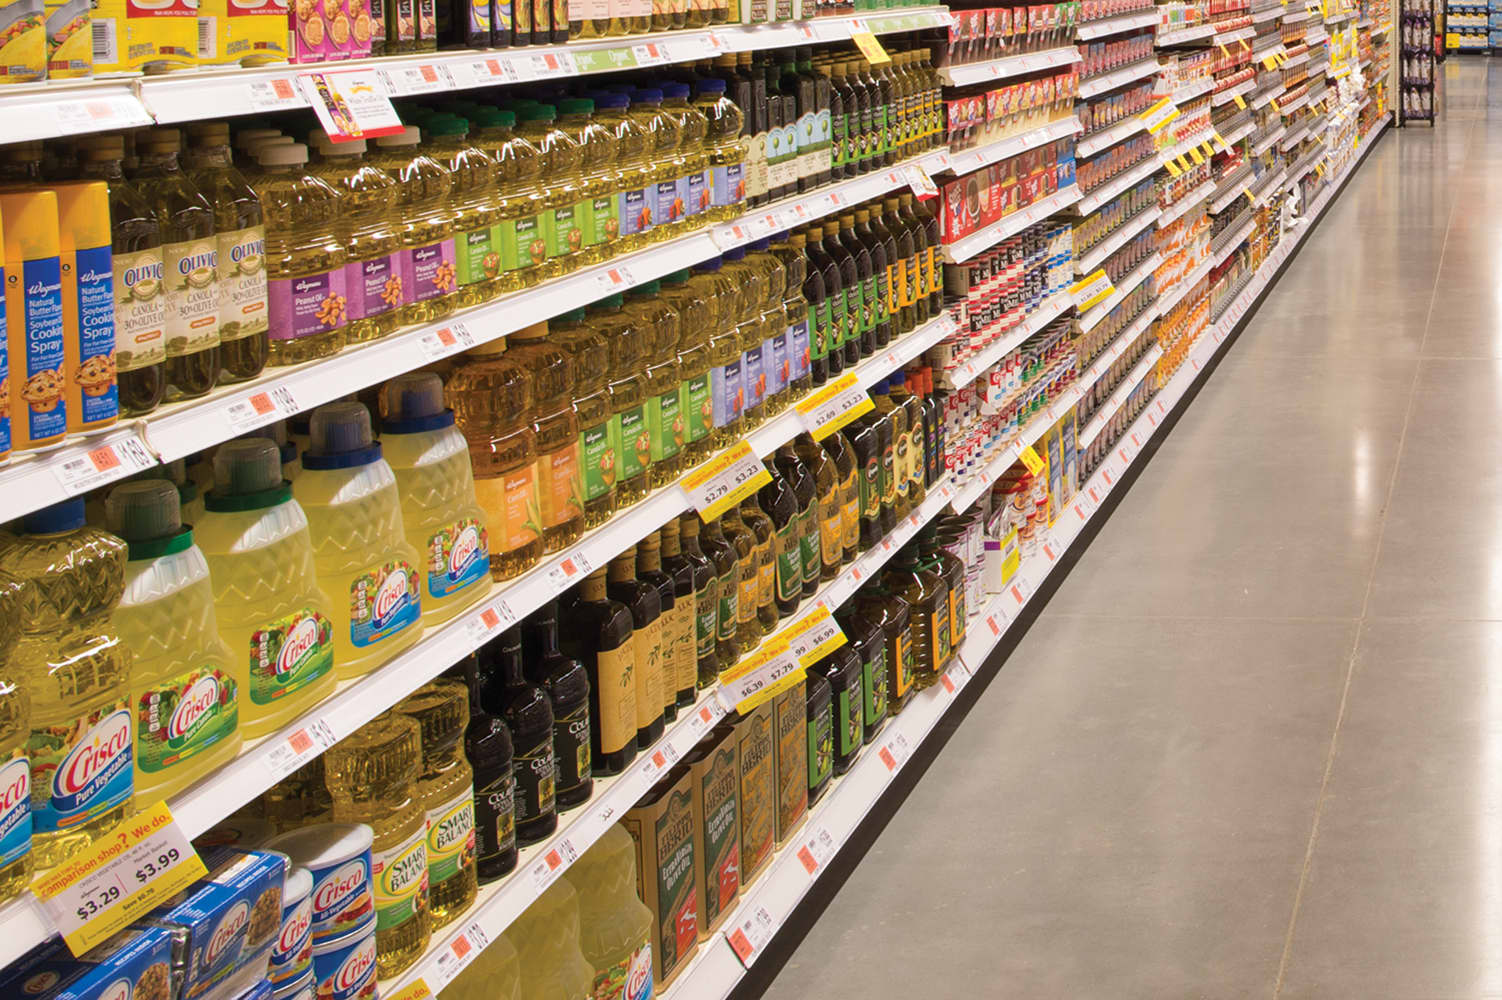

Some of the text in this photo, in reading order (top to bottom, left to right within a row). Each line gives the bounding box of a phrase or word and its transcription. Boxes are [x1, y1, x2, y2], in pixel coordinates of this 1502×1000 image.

[29, 298, 54, 308] Natural
[81, 285, 105, 295] Natural
[31, 341, 60, 354] Spray
[84, 327, 112, 340] Spray
[704, 485, 728, 504] $2.79
[735, 465, 759, 484] $3.23
[280, 625, 316, 672] Crisco
[813, 628, 835, 645] $6.99
[741, 680, 763, 697] $6.39
[173, 687, 215, 735] Crisco
[66, 725, 127, 793] Crisco
[75, 751, 128, 806] Pure Vegetable
[40, 857, 97, 898] comparison
[97, 831, 130, 865] shop?
[131, 822, 151, 840] We
[151, 812, 170, 829] do.
[76, 847, 181, 921] $3.29 $3.99
[315, 868, 363, 912] Crisco
[204, 910, 247, 964] Crisco
